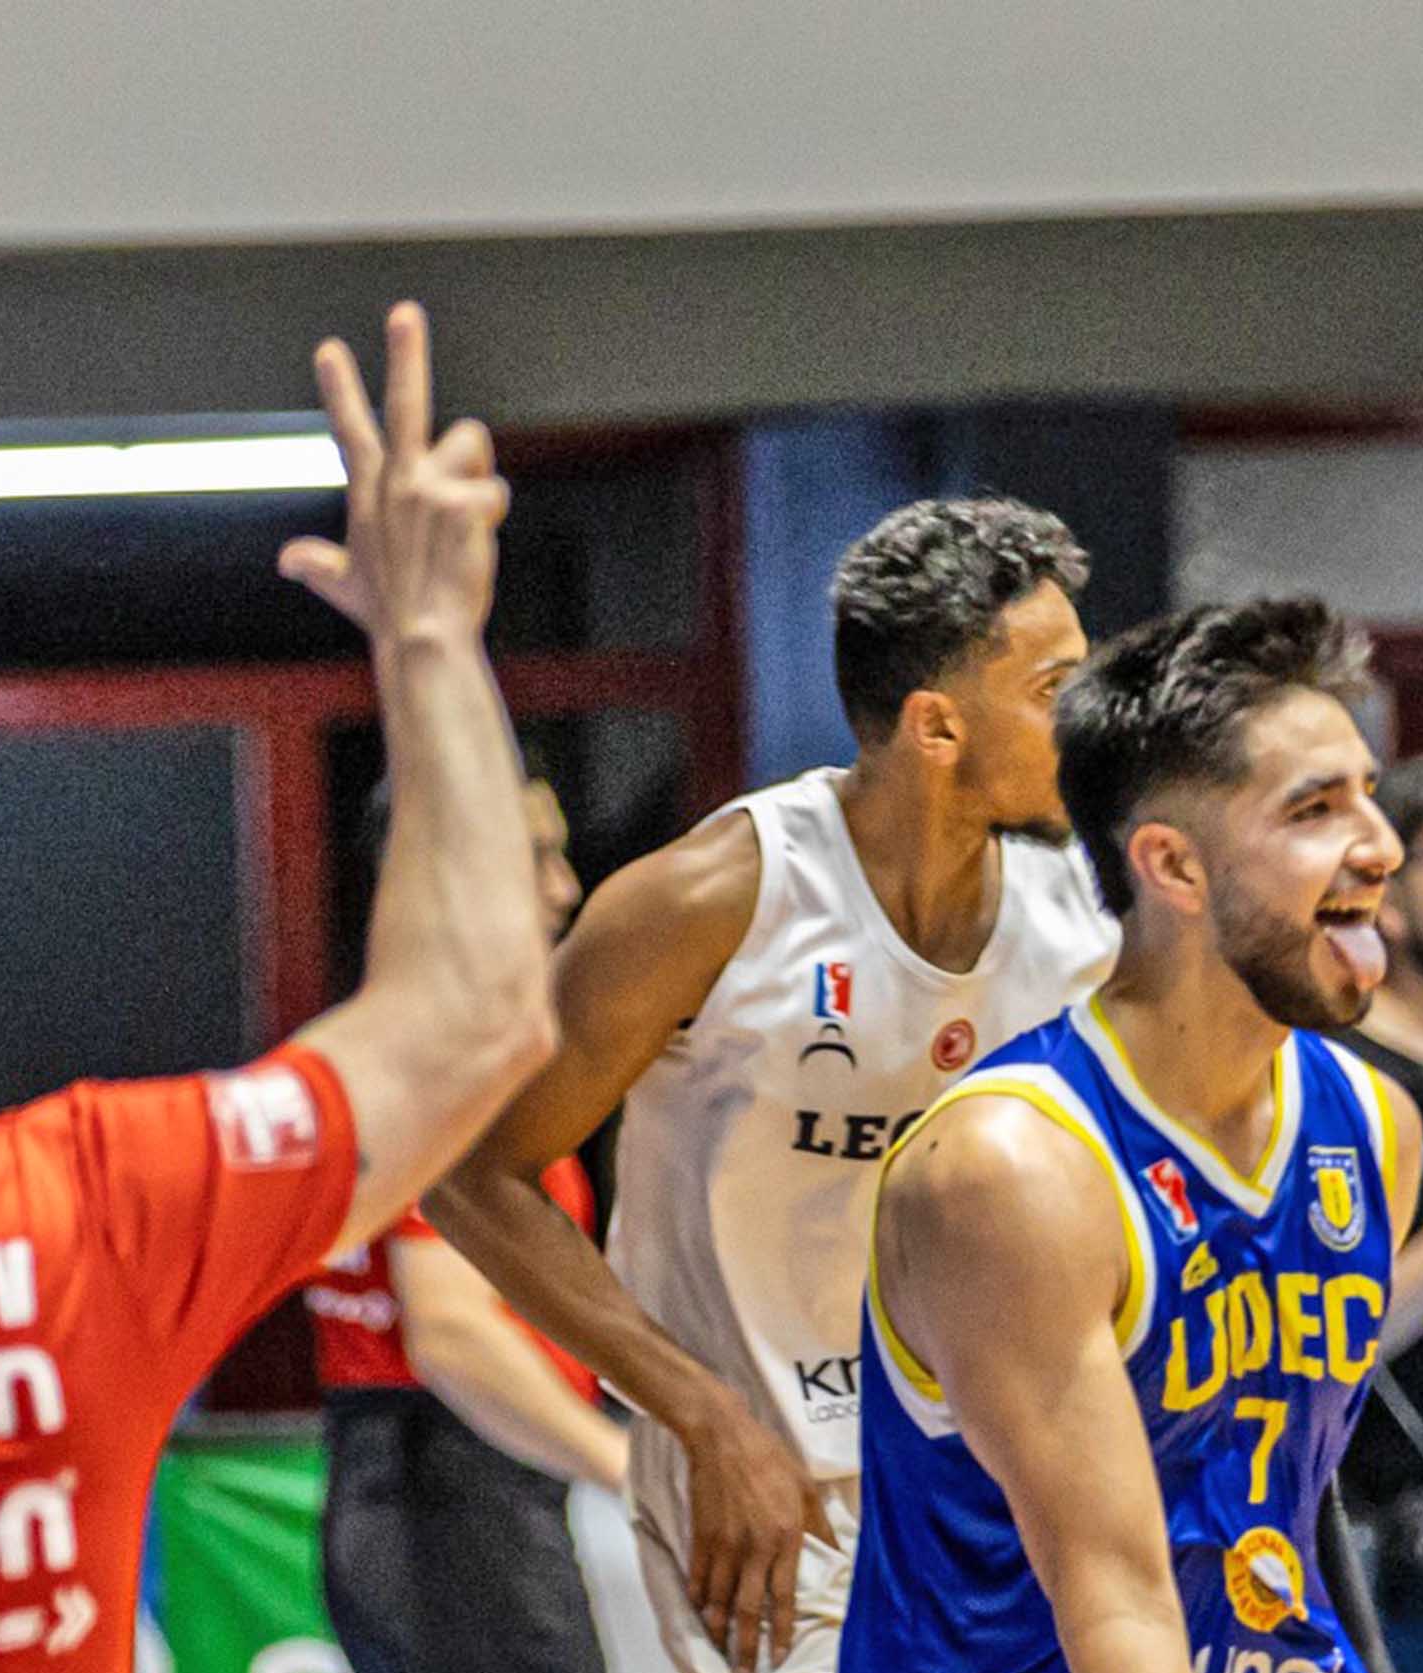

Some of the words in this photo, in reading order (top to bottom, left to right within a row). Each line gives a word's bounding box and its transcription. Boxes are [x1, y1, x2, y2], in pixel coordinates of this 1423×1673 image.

[791, 1110, 924, 1160] LE
[1163, 1272, 1383, 1411] UDEC
[1233, 1398, 1288, 1503] 7
